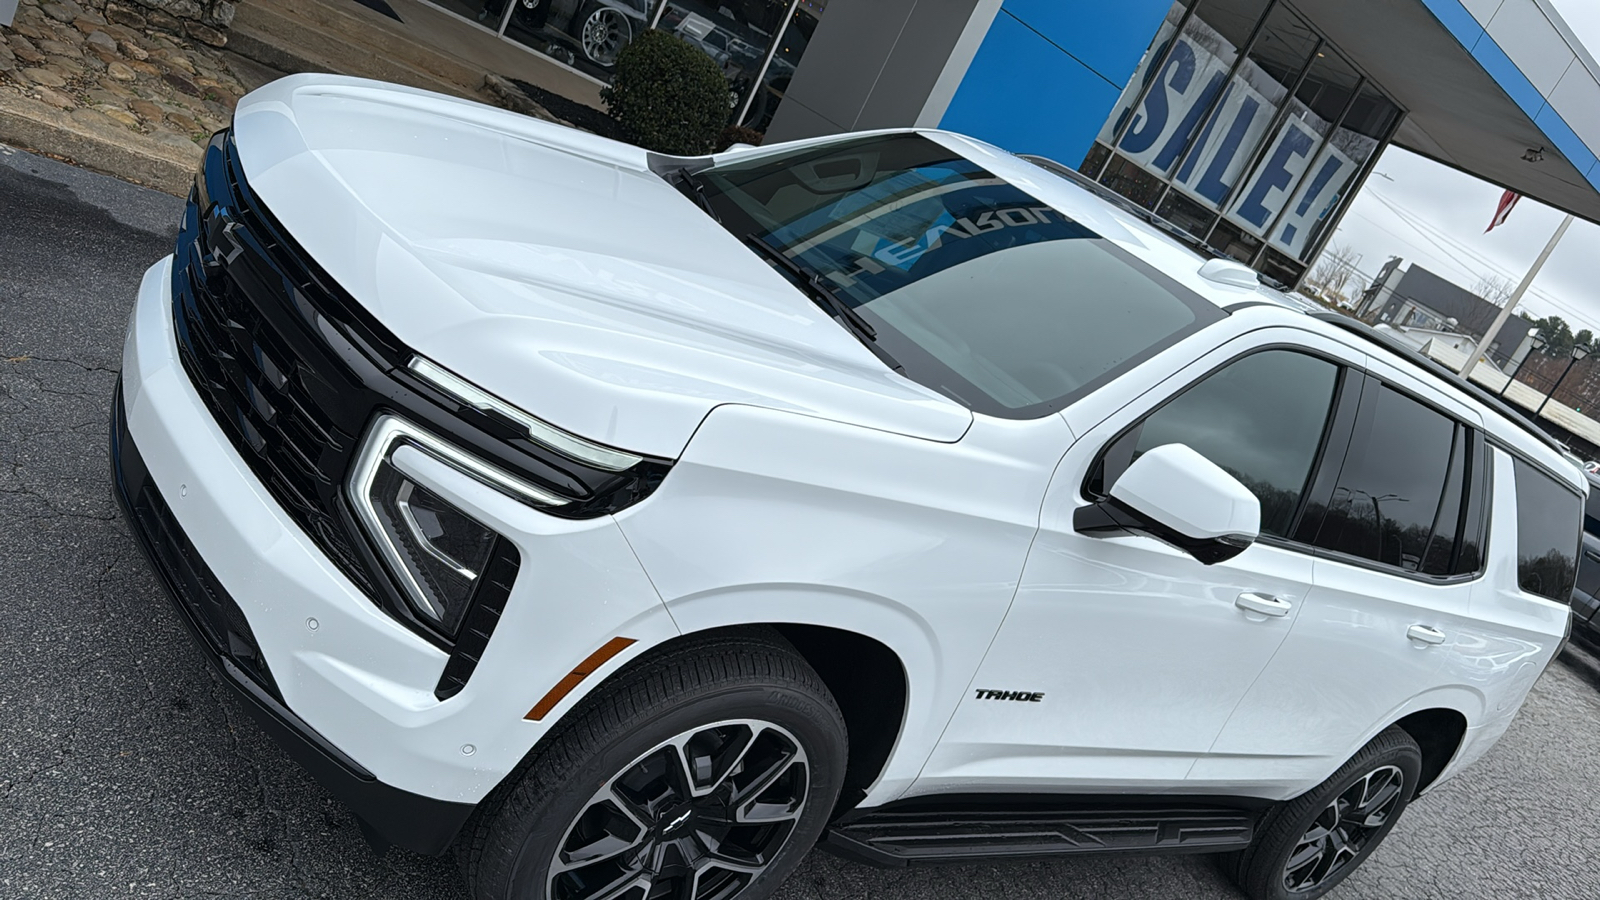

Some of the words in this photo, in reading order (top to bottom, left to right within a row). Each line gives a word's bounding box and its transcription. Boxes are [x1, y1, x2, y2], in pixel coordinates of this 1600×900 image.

[1113, 37, 1344, 247] SALE!
[767, 690, 832, 733] BRIDGESTO
[975, 688, 1046, 703] TAHOE
